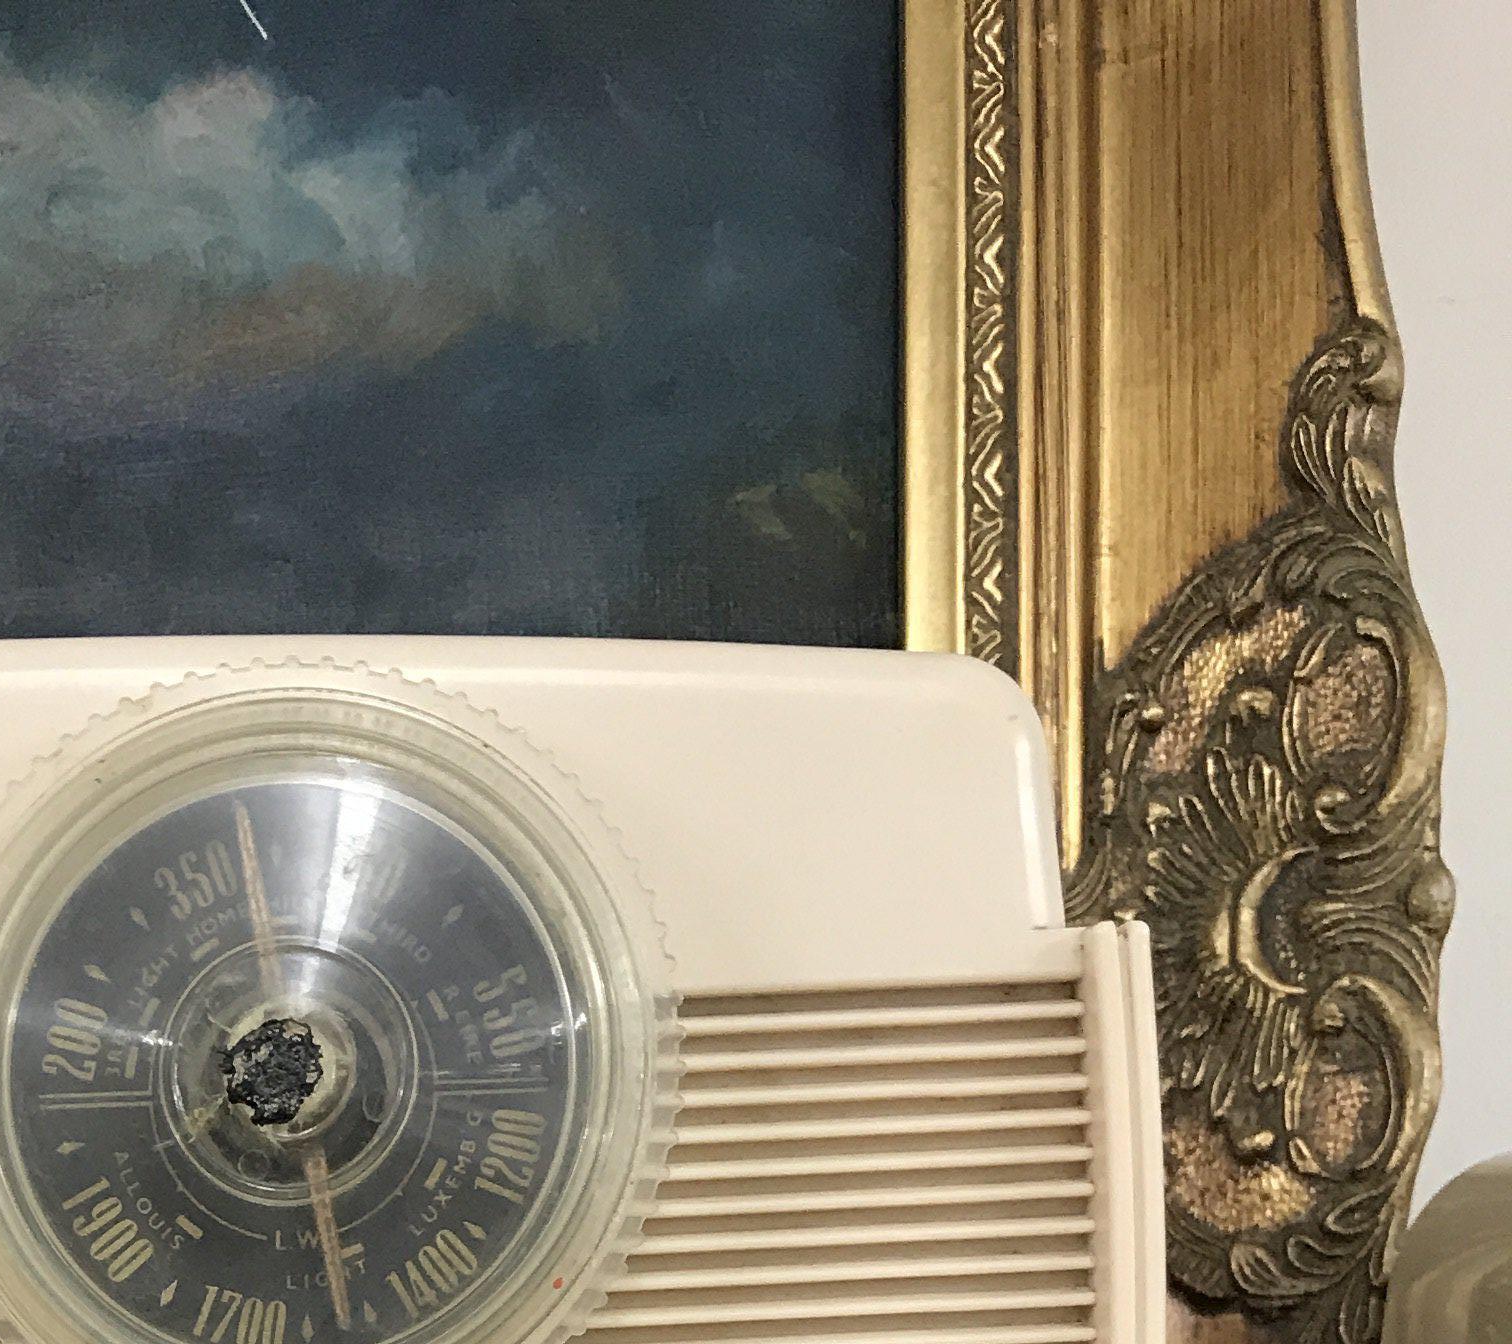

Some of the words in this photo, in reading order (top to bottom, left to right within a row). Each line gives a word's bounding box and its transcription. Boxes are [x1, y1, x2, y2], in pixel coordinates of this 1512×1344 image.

[153, 838, 239, 922] 350
[41, 997, 109, 1083] 200
[473, 964, 545, 1059] 550
[114, 1150, 185, 1251] ALLOUIS
[474, 1109, 546, 1205] 1200
[61, 1175, 154, 1283] 1900
[385, 1229, 478, 1320] 1400
